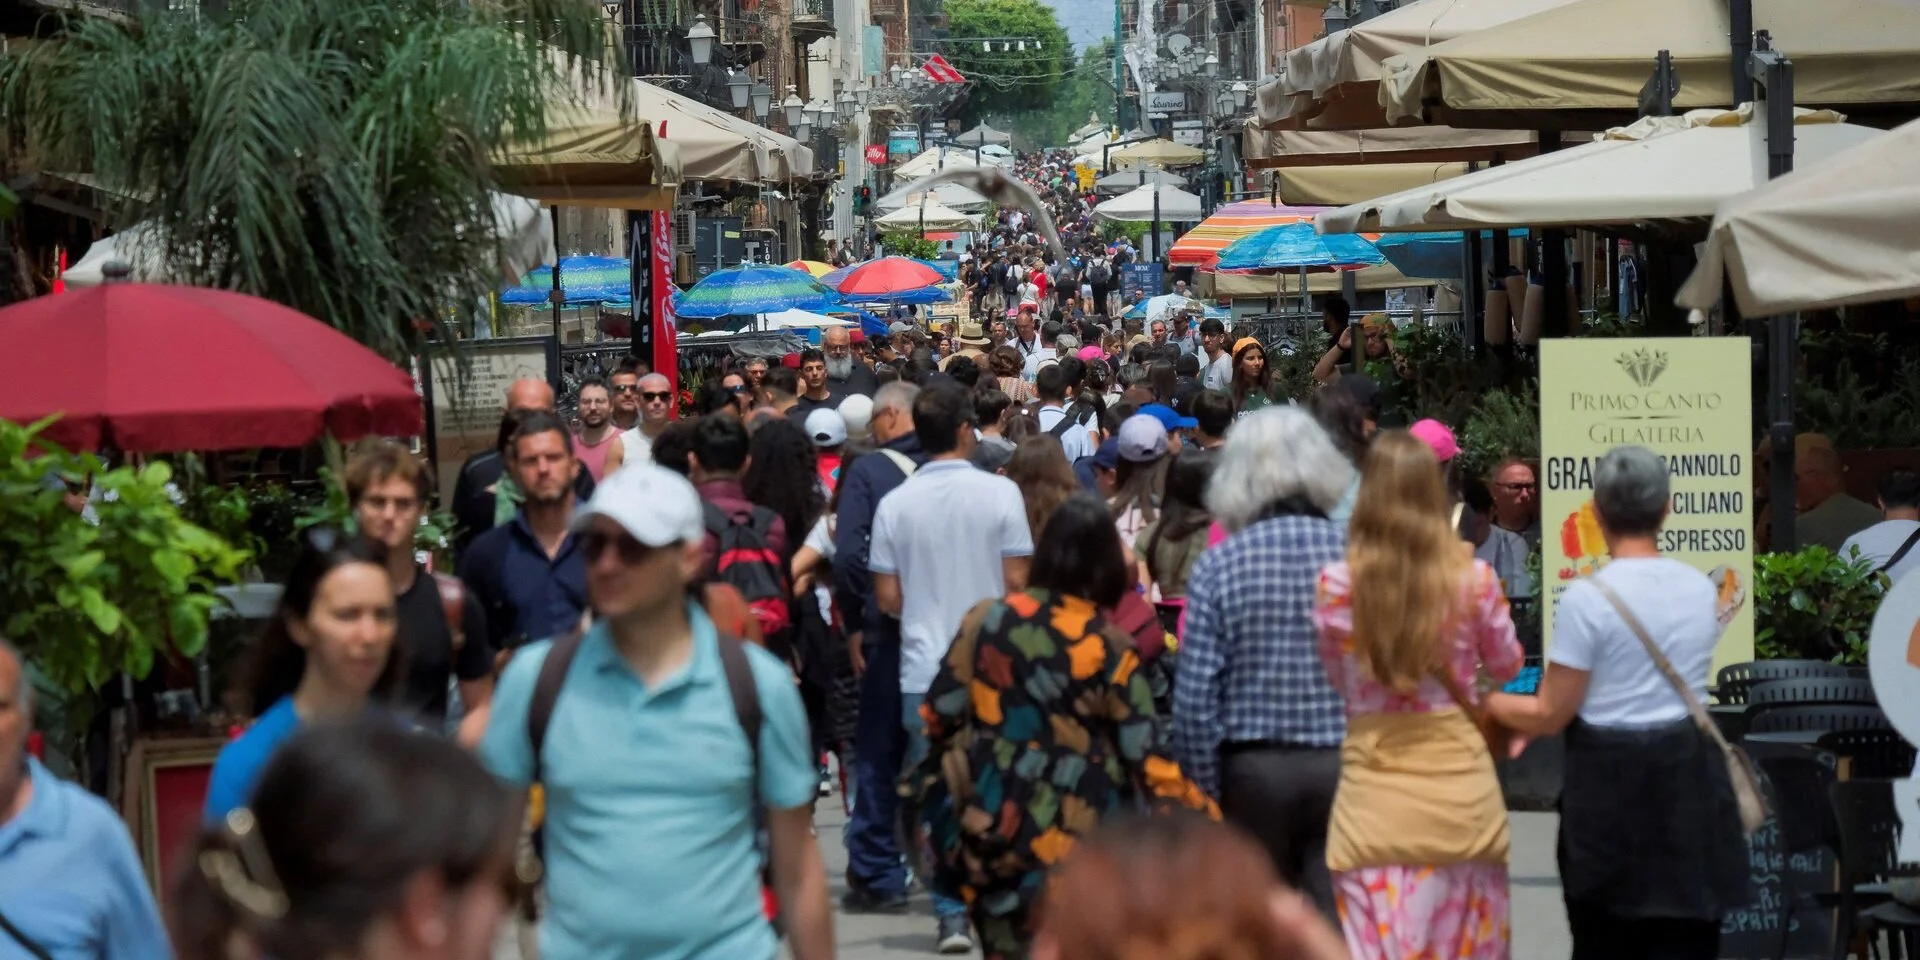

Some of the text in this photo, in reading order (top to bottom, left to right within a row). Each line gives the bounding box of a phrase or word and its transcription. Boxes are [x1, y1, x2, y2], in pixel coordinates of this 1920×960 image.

[867, 148, 884, 160] illy
[1571, 390, 1722, 411] PRIMO CANTO
[1588, 423, 1704, 444] GELATERIA
[1673, 491, 1743, 514] CILIANO
[1657, 529, 1745, 552] ESPRESSO
